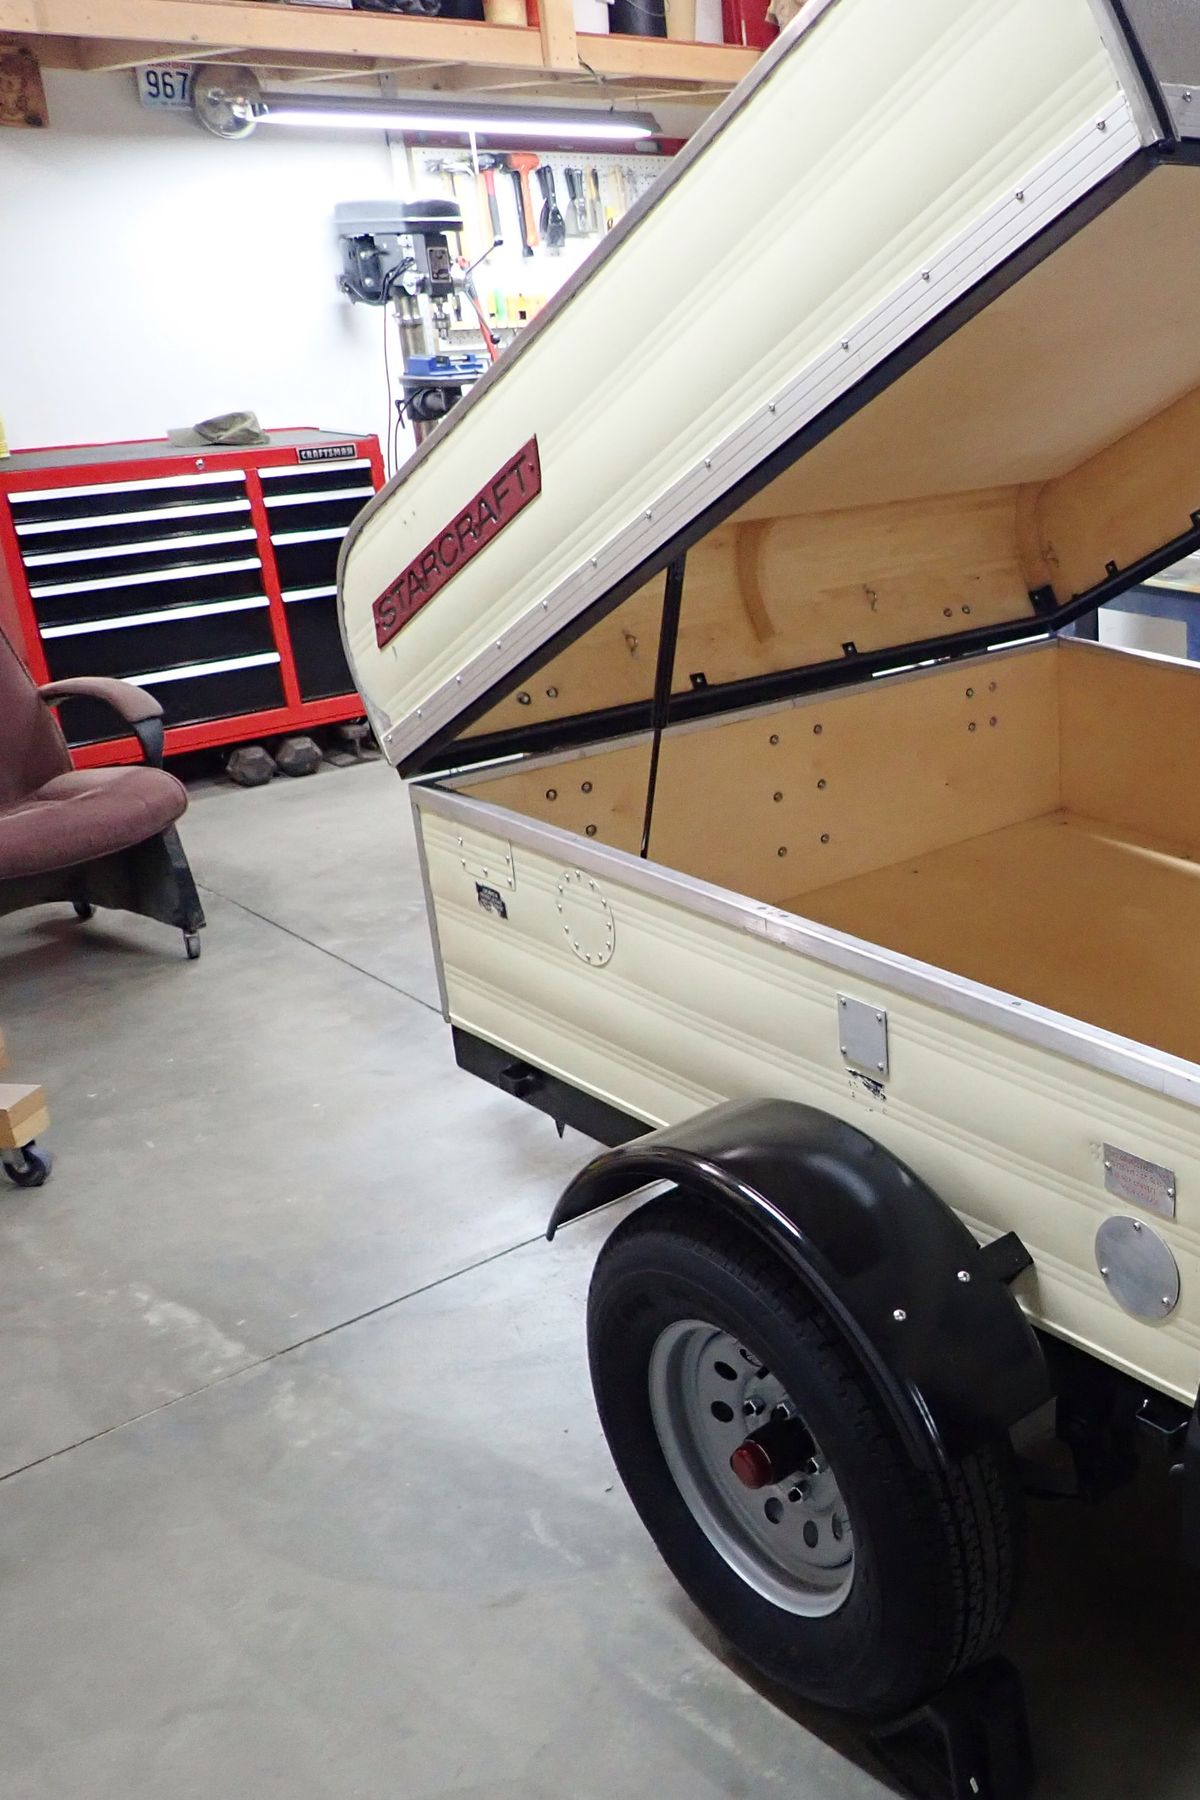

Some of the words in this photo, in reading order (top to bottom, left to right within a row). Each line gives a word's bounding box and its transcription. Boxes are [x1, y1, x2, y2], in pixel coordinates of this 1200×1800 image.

[146, 70, 188, 99] 967
[301, 447, 353, 459] CRAFTSMAN
[378, 454, 527, 628] STARCRAFT
